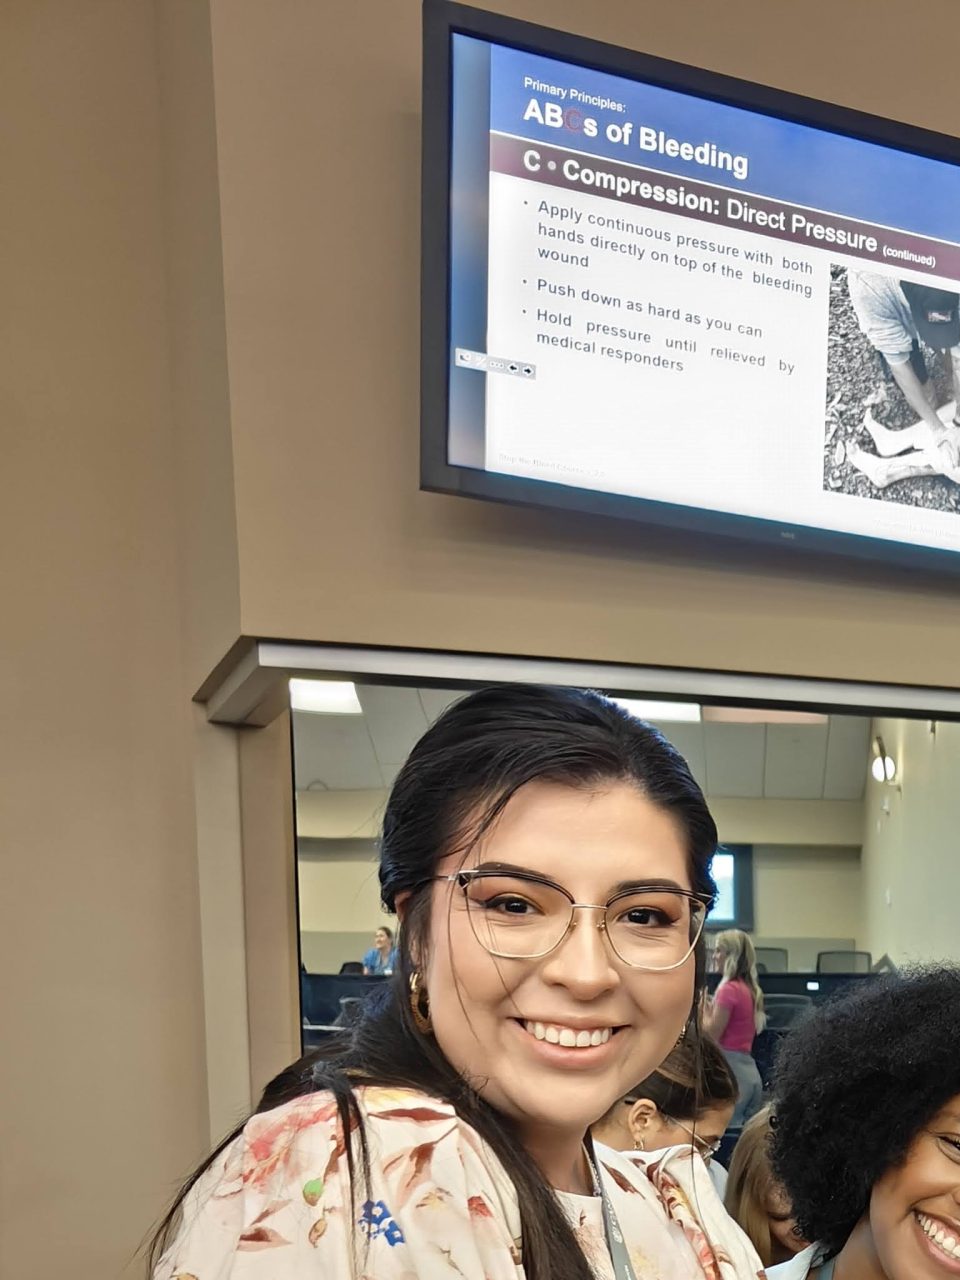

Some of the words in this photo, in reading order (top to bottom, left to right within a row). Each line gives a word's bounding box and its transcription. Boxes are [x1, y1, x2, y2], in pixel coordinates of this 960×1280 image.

[524, 76, 567, 100] Primary
[570, 88, 626, 113] Principles:
[606, 122, 632, 145] of
[640, 128, 749, 180] Bleeding
[524, 150, 540, 172] C
[563, 159, 720, 215] Compression:
[726, 198, 786, 231] Direct
[792, 216, 878, 252] Pressure
[882, 244, 937, 268] (continued)
[538, 200, 582, 224] Apply
[587, 212, 672, 242] continuous
[676, 234, 740, 258] pressure
[744, 249, 774, 266] with
[782, 257, 814, 275] both
[538, 248, 590, 268] wound
[538, 222, 584, 244] hands
[590, 236, 646, 261] directly
[650, 250, 669, 264] on
[674, 254, 698, 271] top
[702, 260, 717, 274] of
[721, 263, 744, 280] the
[752, 270, 813, 299] bleeding
[538, 278, 576, 298] Push
[581, 289, 622, 308] down
[626, 299, 643, 312] as
[648, 303, 681, 321] hard
[685, 312, 701, 325] as
[706, 316, 733, 333] you
[738, 322, 762, 338] can
[537, 308, 572, 327] Hold
[586, 320, 651, 344] pressure
[665, 336, 697, 353] until
[710, 344, 766, 368] relieved
[779, 358, 795, 374] by
[537, 332, 596, 354] medical
[600, 344, 684, 372] responders
